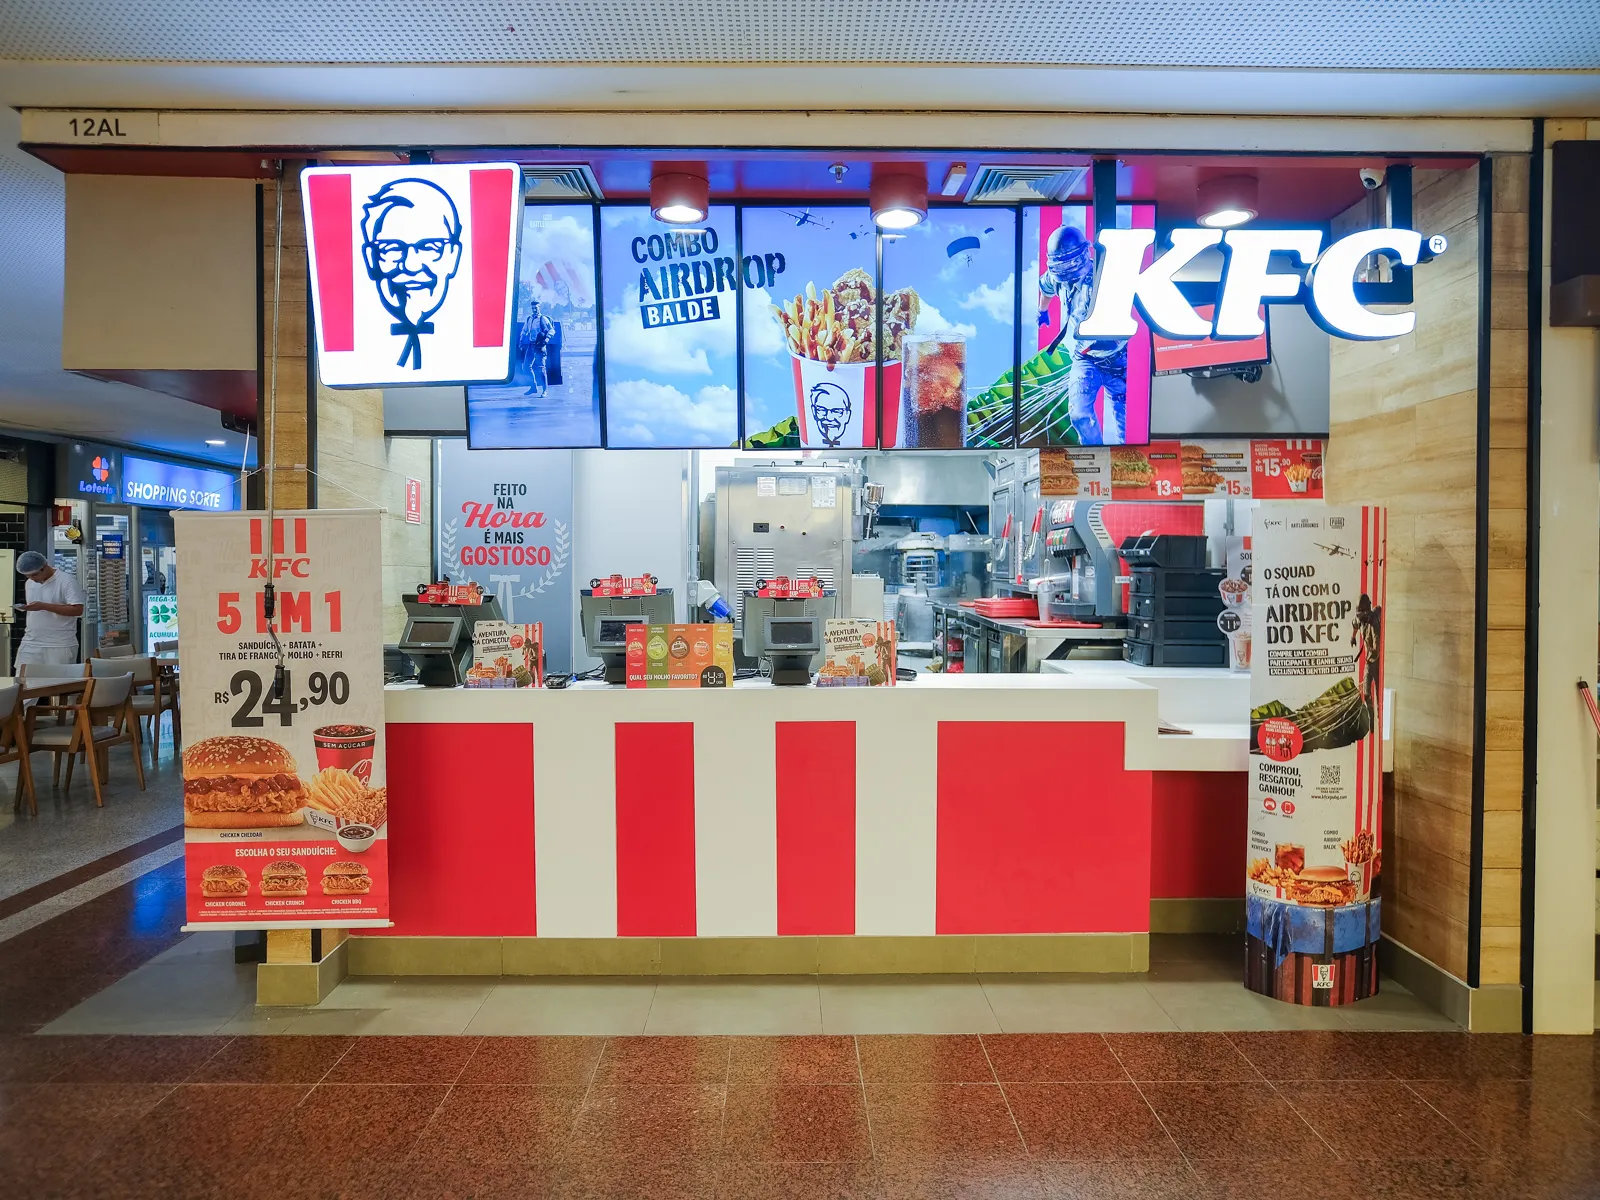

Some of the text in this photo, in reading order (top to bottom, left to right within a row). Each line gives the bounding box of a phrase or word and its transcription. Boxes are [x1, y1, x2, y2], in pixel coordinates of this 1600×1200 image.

[69, 118, 127, 137] 12AL
[631, 227, 718, 263] COMBO
[639, 252, 786, 302] AIRDROP
[1075, 228, 1422, 340] KFC
[647, 299, 714, 326] BALDE
[126, 481, 221, 508] SHOPPING SORTE
[493, 483, 527, 496] FEITO
[497, 496, 514, 509] NA
[461, 501, 548, 529] Hora
[484, 529, 524, 544] É MAIS
[460, 546, 551, 566] GOSTOSO
[248, 558, 311, 578] KFC
[1264, 565, 1315, 580] O SQUAD
[1265, 583, 1340, 598] TÁ ON COM O
[217, 590, 342, 634] 5 EM 1
[1266, 600, 1352, 623] AIRDROP
[478, 630, 507, 638] AVENTURA
[830, 629, 858, 637] AVENTURA
[1266, 622, 1340, 644] DO KFC
[238, 640, 282, 650] SANDUÍCH
[289, 641, 316, 649] BATATA
[288, 651, 313, 659] MOLHO
[322, 650, 343, 659] REFRI
[214, 670, 350, 727] R$ 24,90
[1259, 762, 1301, 777] COMPROU,
[1259, 773, 1303, 788] RESGATOU,
[1259, 783, 1295, 797] GANHOU!
[318, 816, 333, 826] KFC
[235, 848, 268, 857] ESCOLHA
[276, 848, 290, 856] SEU
[292, 846, 337, 856] SANDUÍCHE:
